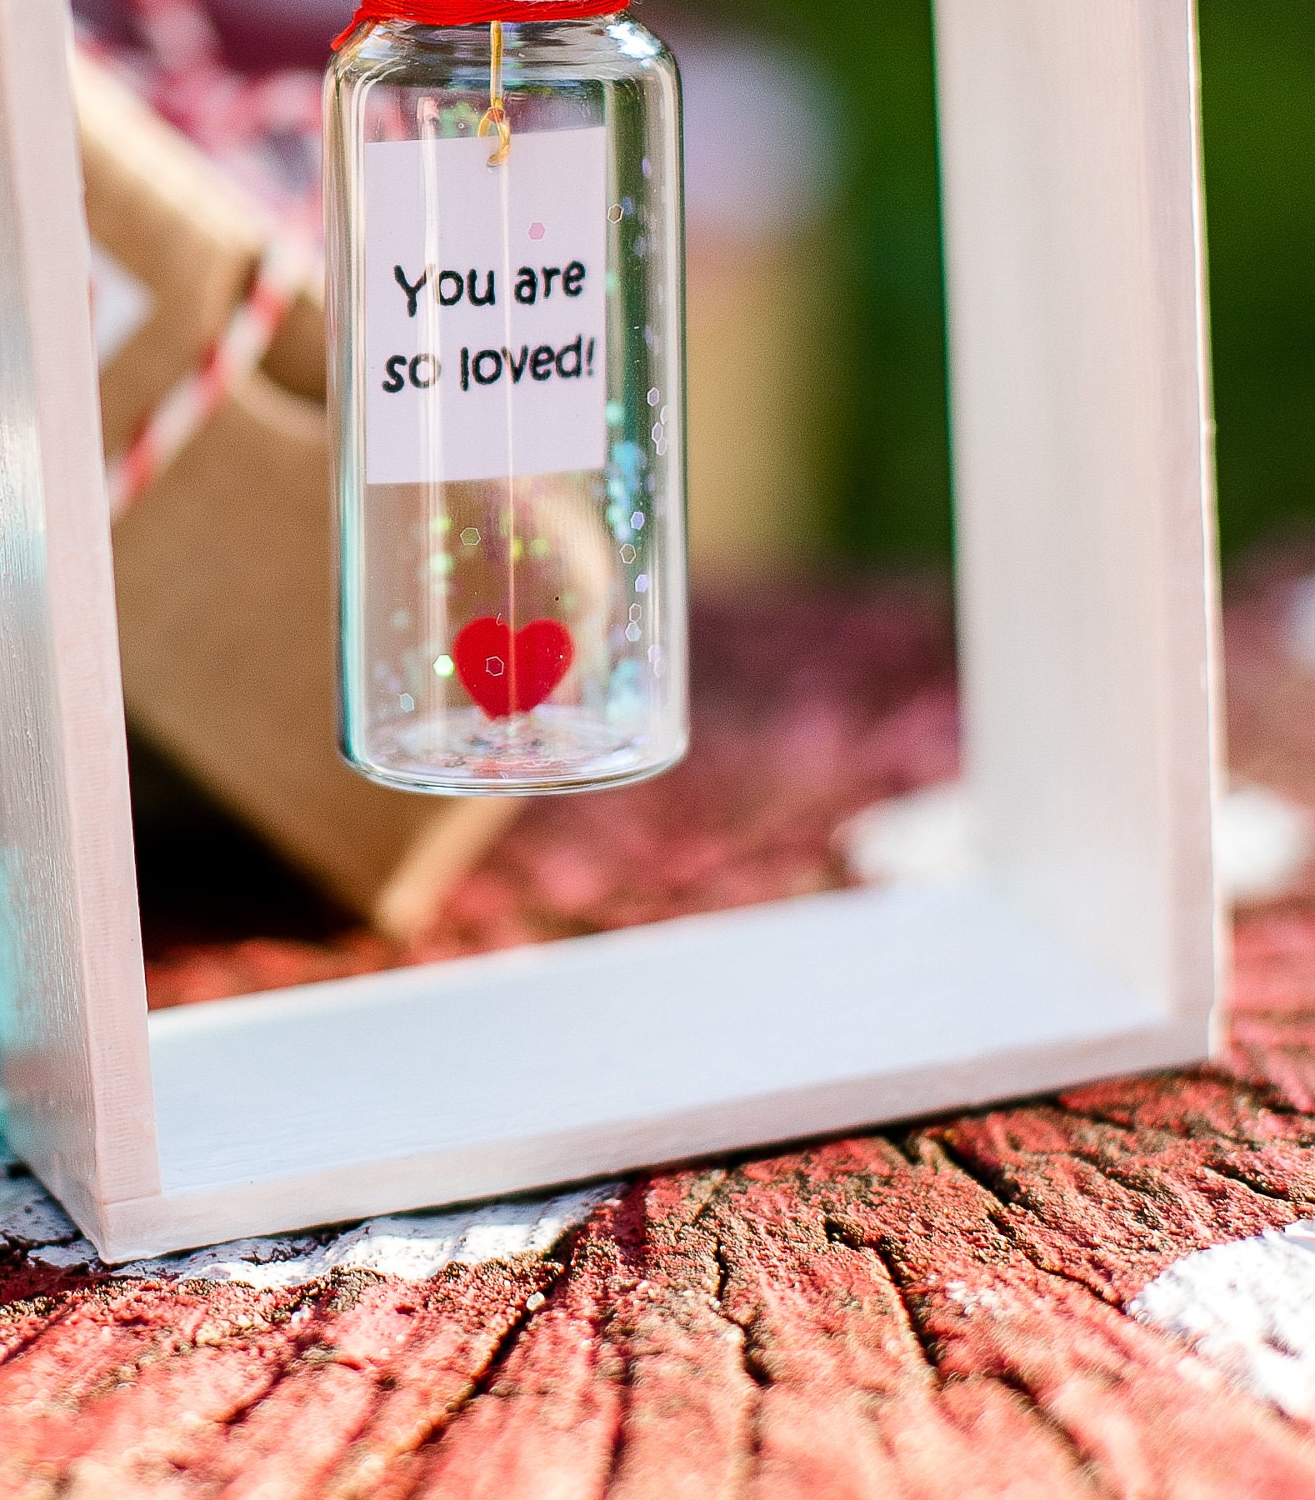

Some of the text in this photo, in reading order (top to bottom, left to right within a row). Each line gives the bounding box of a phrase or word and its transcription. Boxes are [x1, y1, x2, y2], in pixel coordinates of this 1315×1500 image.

[393, 260, 586, 318] You are
[382, 334, 596, 393] so loved!
